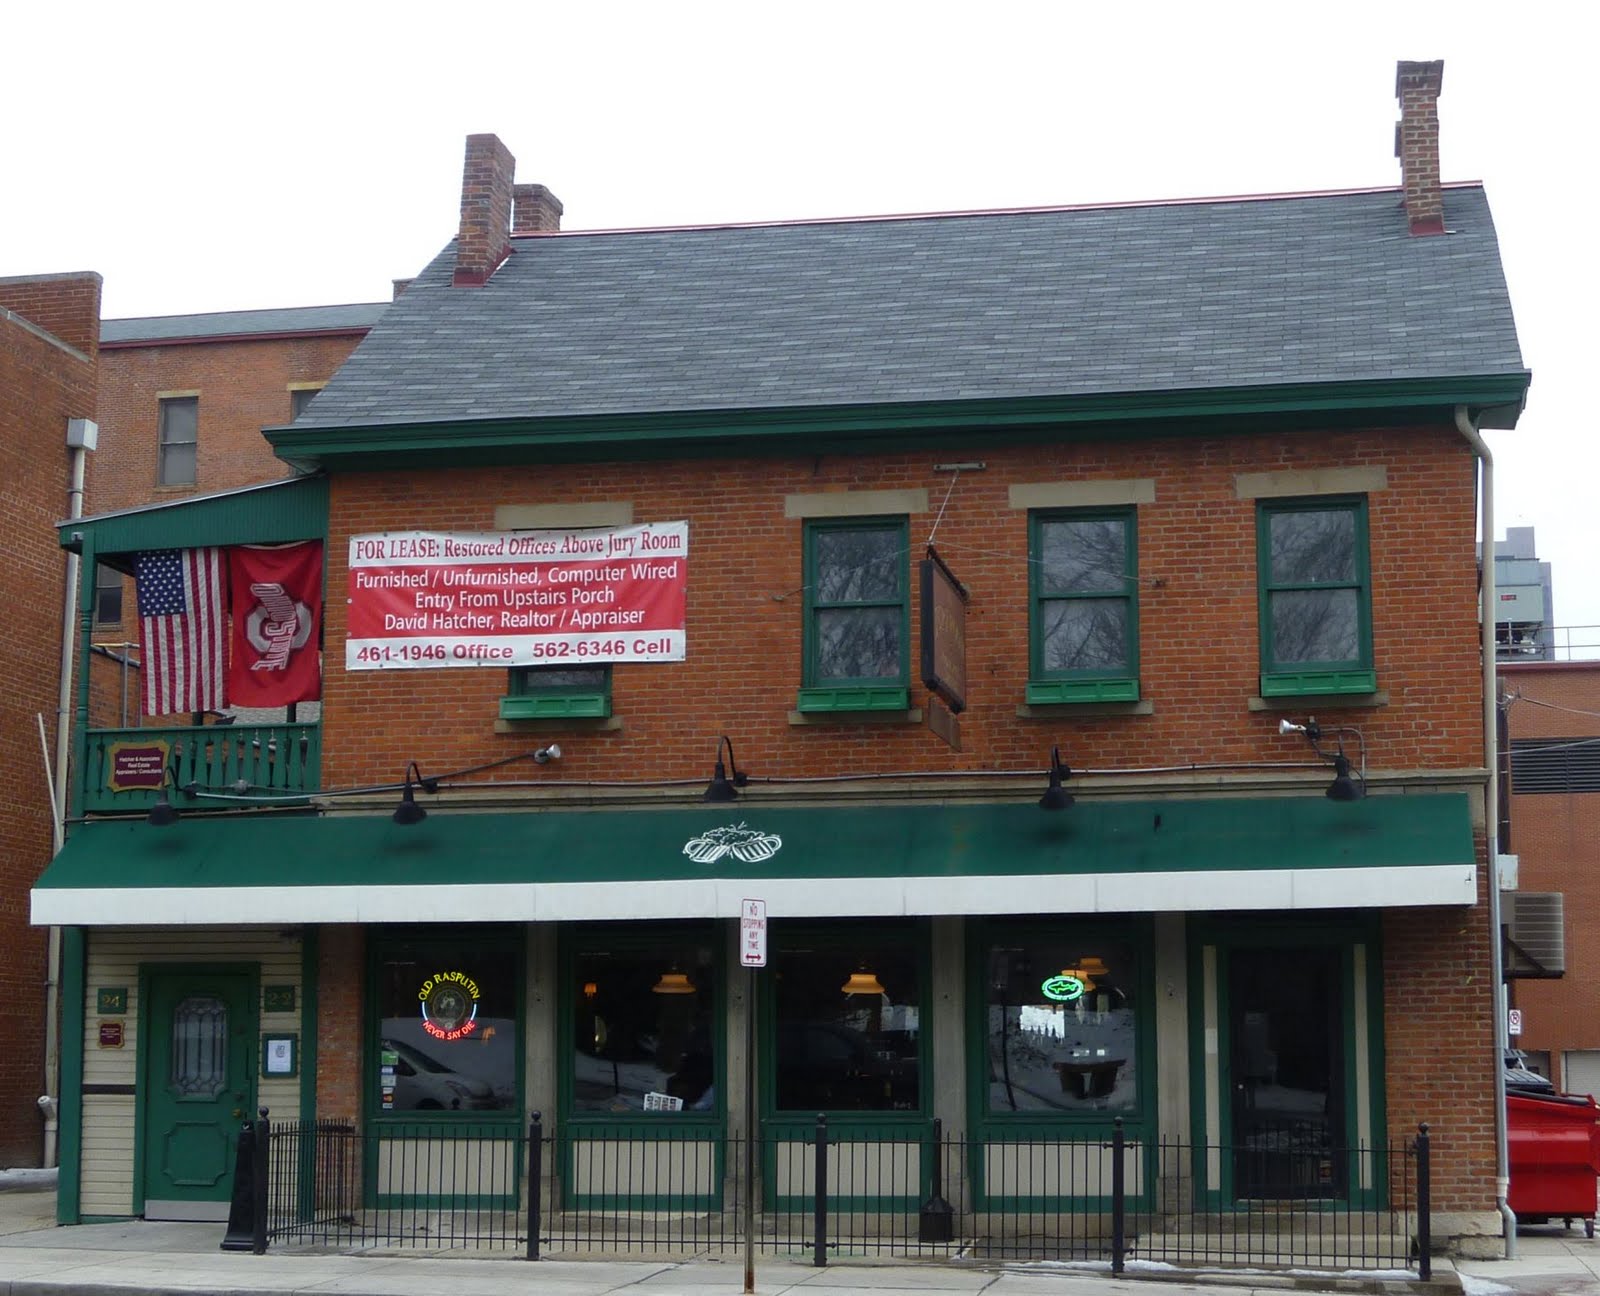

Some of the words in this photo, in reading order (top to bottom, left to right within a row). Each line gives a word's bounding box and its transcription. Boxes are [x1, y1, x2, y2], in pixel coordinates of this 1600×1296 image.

[356, 540, 385, 559] FOR
[390, 538, 440, 558] LEASE:
[444, 538, 505, 557] Restored
[509, 538, 556, 555] Offices
[560, 535, 603, 554] Above
[606, 534, 637, 558] Jury
[641, 532, 681, 550] Room
[356, 570, 428, 588] Furnished
[432, 570, 440, 588] /
[443, 567, 542, 586] Unfurnished,
[548, 567, 626, 586] Computer
[631, 561, 678, 580] Wired
[415, 592, 454, 612] Entry
[459, 590, 498, 607] From
[504, 588, 566, 609] Upstairs
[572, 585, 615, 604] Porch
[385, 612, 427, 630] David
[432, 612, 495, 631] Hatcher,
[501, 610, 556, 628] Realtor
[559, 609, 567, 629] /
[570, 607, 645, 629] Appraiser
[250, 619, 297, 671] STATE
[356, 645, 446, 662] 461-1946
[453, 644, 513, 660] Office
[532, 639, 625, 658] 562-6346
[633, 638, 671, 654] Cell
[749, 905, 758, 916] NO
[749, 931, 758, 940] ANY
[418, 980, 433, 1000] OLD
[433, 971, 480, 999] RASPUTIN
[423, 1021, 445, 1039] NEVER
[447, 1031, 461, 1040] SAY
[461, 1021, 475, 1034] DIE
